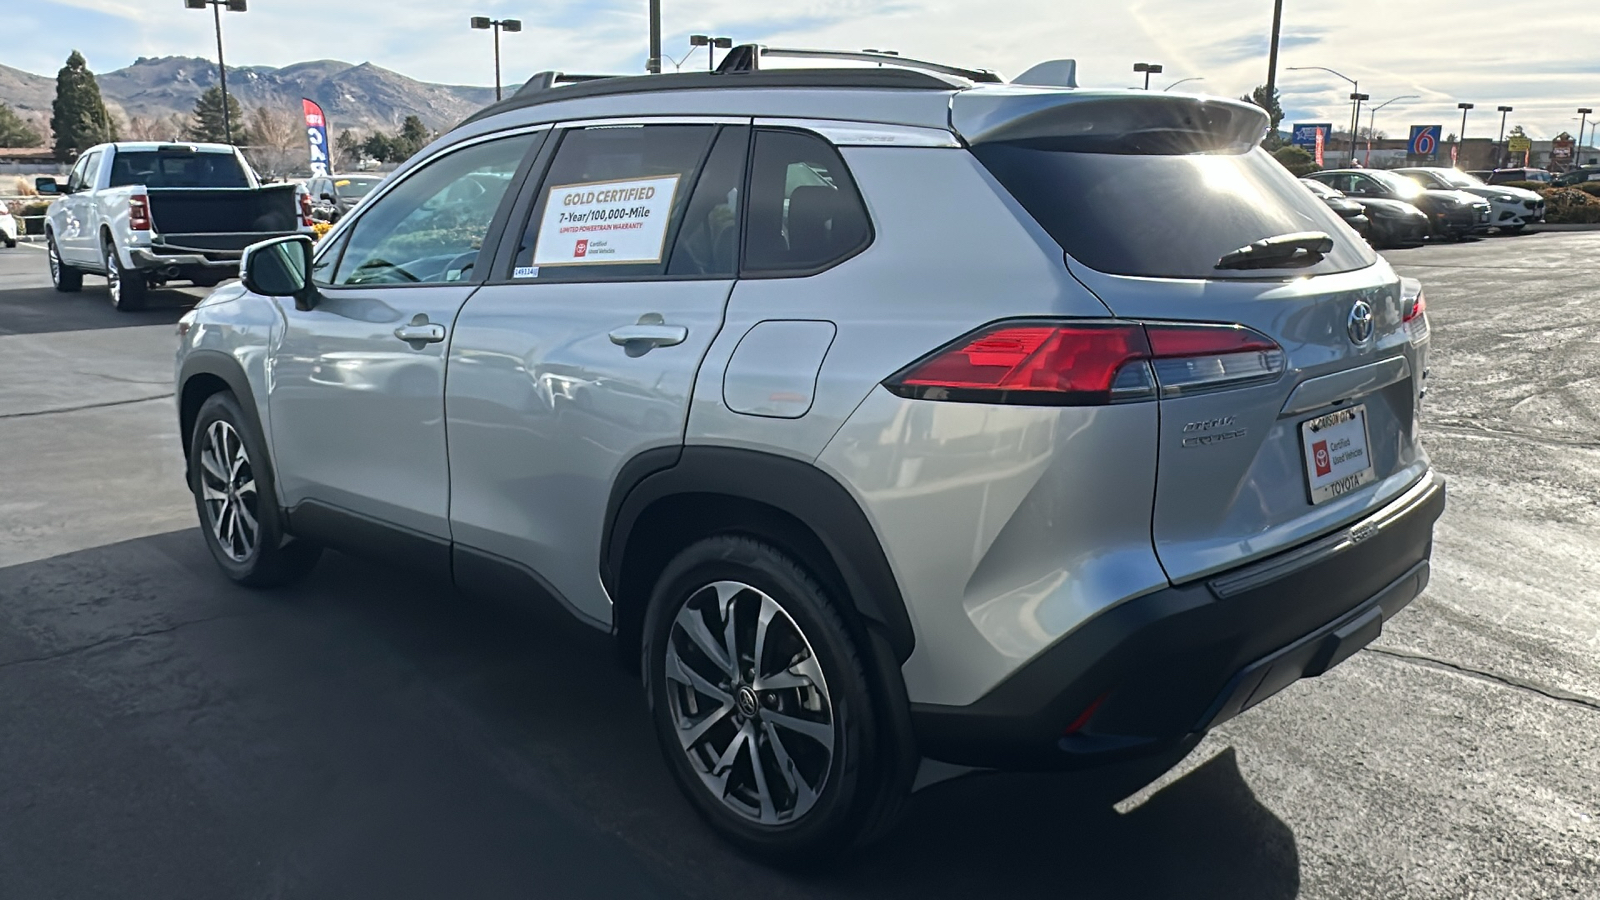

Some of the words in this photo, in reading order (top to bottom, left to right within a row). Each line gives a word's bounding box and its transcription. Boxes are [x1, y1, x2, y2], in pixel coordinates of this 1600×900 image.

[1414, 126, 1435, 155] 6
[563, 192, 595, 206] GOLD
[596, 186, 655, 203] CERTIFIED
[559, 206, 650, 224] 7-Year/100,000-Mile
[559, 226, 579, 234] LIMITED
[578, 224, 613, 233] POWERTRAIN
[612, 222, 643, 230] WARRANTY
[1318, 414, 1338, 430] CARSON
[1330, 438, 1350, 451] Certified
[1332, 452, 1345, 465] Used
[1345, 448, 1363, 462] Vehicles
[1330, 475, 1360, 496] TOYOTA
